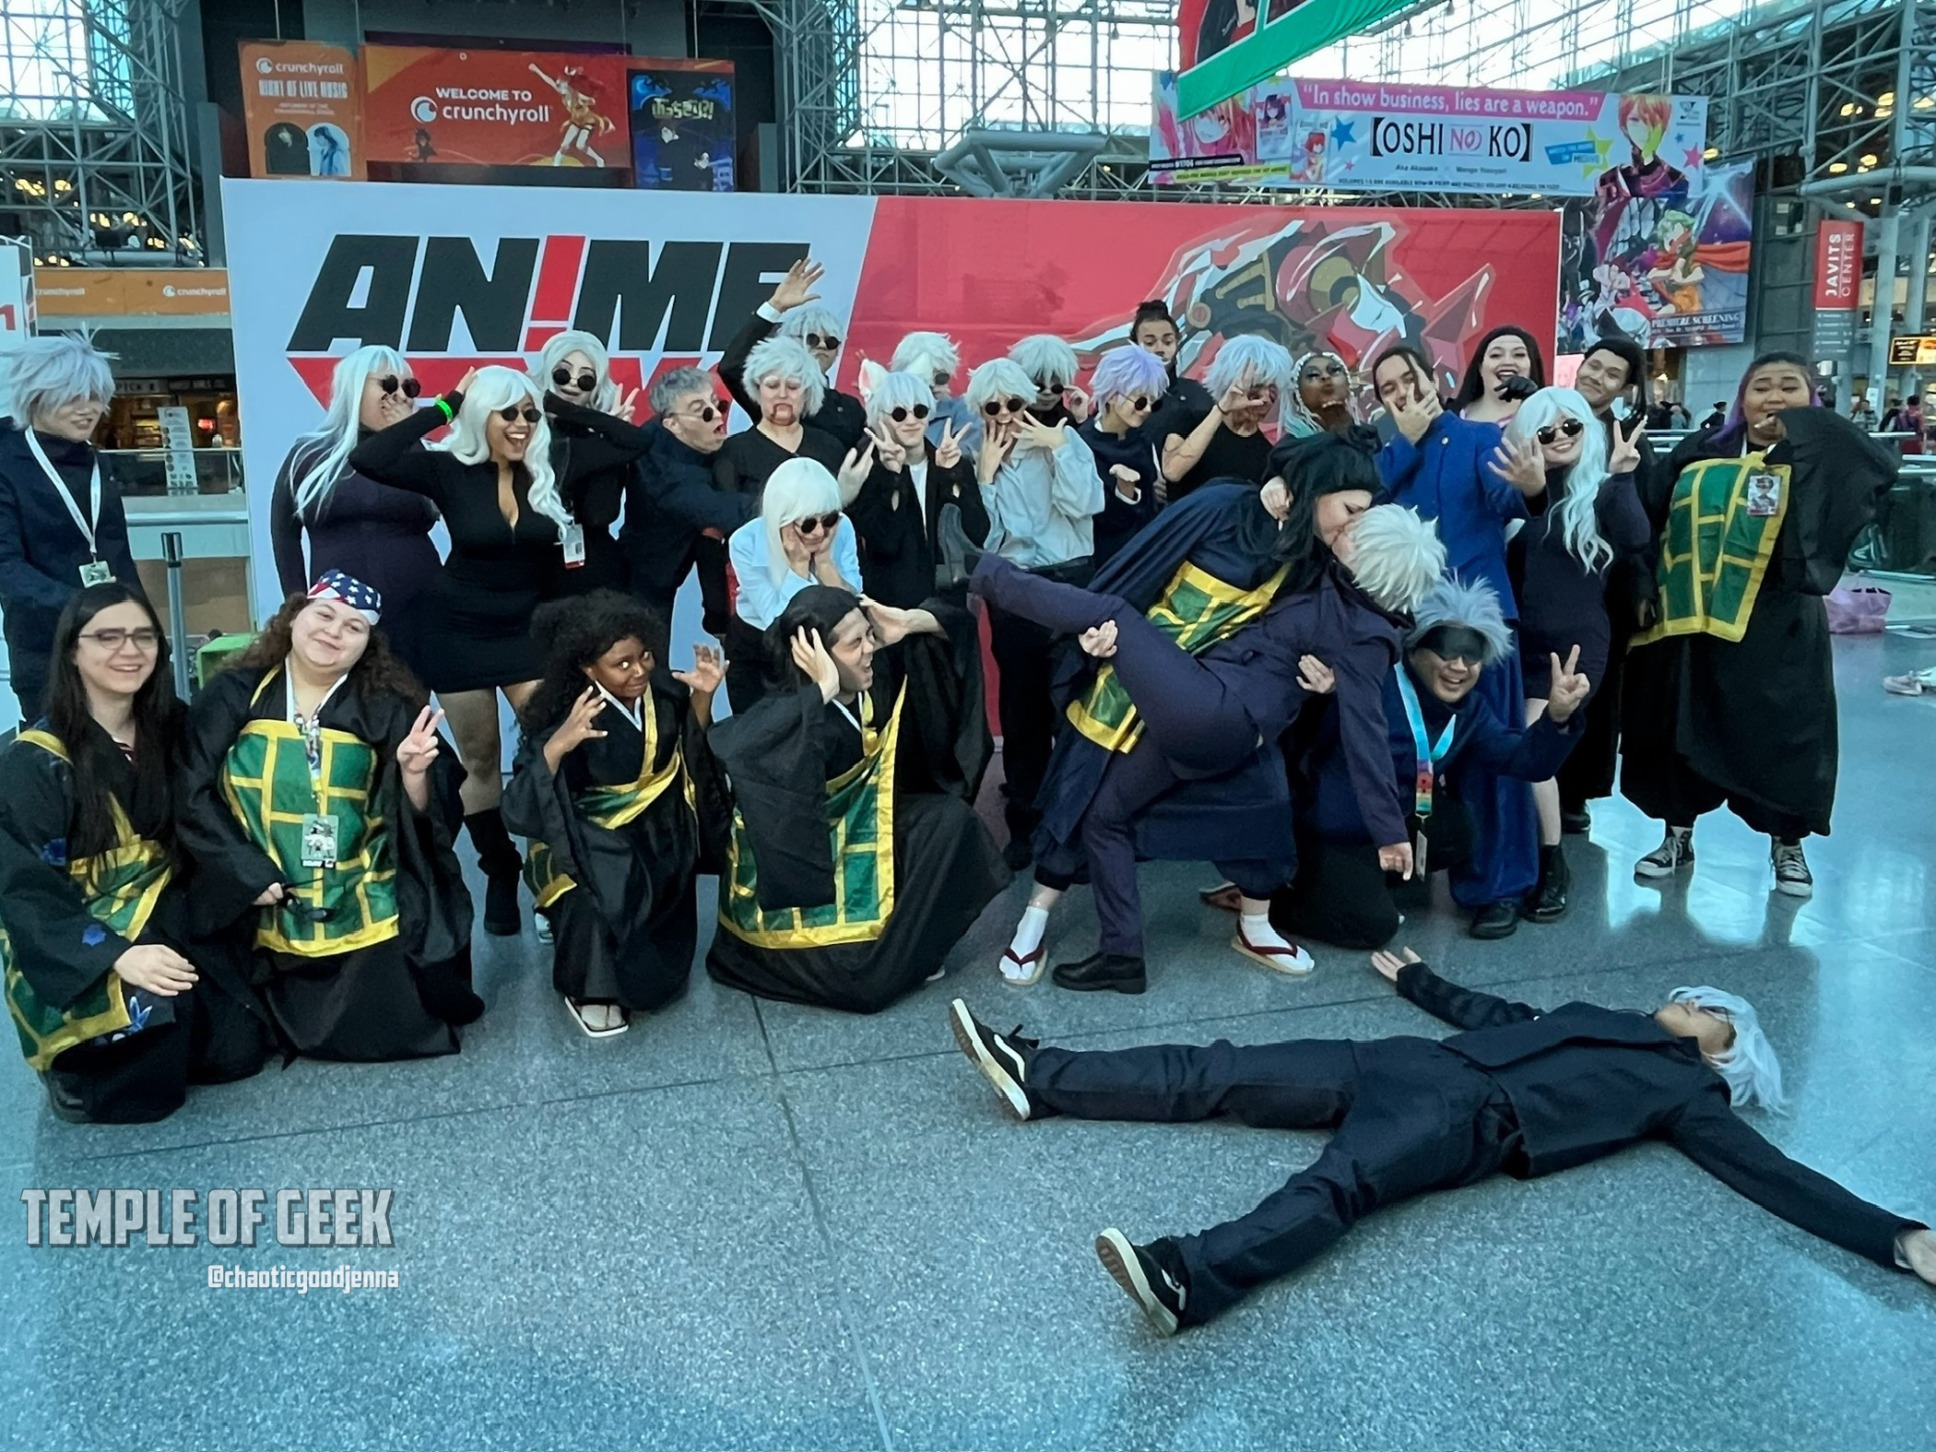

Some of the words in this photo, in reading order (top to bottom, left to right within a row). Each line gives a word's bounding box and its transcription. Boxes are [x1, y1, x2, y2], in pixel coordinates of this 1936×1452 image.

[275, 62, 344, 75] crunchyroll
[436, 87, 509, 101] WELCOME
[511, 90, 532, 102] TO
[1334, 86, 1376, 106] show
[1380, 88, 1449, 112] business,
[1455, 91, 1480, 111] lies
[1484, 97, 1509, 112] are
[1512, 99, 1522, 113] a
[442, 103, 549, 125] crunchyroll
[1825, 233, 1841, 297] JAVITS
[1841, 232, 1855, 297] CENTER
[177, 287, 227, 297] crunchyroll
[1692, 313, 1740, 326] SCREENING
